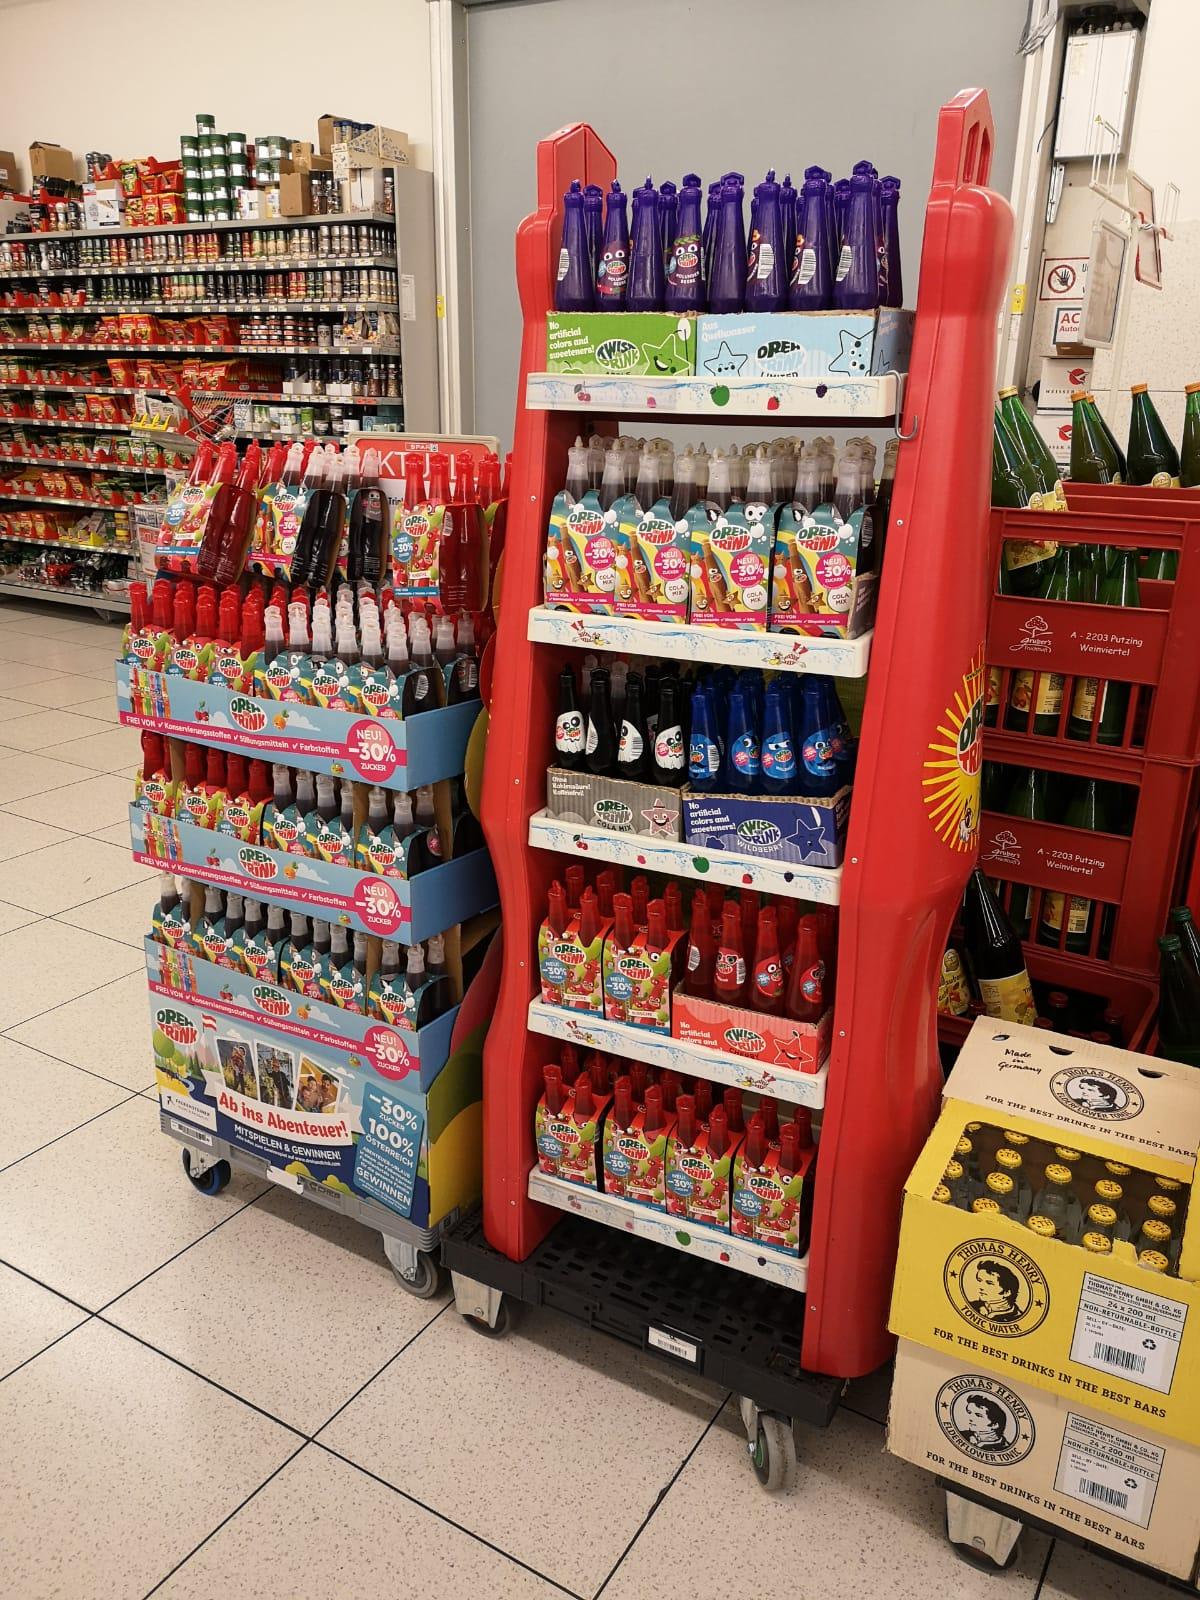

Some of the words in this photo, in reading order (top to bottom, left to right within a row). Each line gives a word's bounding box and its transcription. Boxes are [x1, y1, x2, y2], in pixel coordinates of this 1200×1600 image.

[549, 321, 560, 330] No
[702, 321, 719, 331] Aus
[549, 327, 581, 340] artificial
[549, 339, 573, 350] colors
[573, 336, 589, 346] and
[597, 340, 637, 360] TWIST
[757, 340, 801, 359] DREH
[549, 345, 595, 360] sweeteners!
[599, 348, 640, 370] DRINK
[638, 520, 673, 532] DREH
[799, 526, 835, 540] DREH
[654, 558, 686, 569] -30%
[816, 564, 850, 576] -30%
[1070, 631, 1077, 639] A
[1085, 632, 1109, 642] 2203
[1110, 634, 1144, 648] Putzing
[1079, 643, 1131, 656] Weinviertel
[231, 698, 261, 712] DREH
[126, 715, 140, 725] FREI
[141, 718, 155, 728] VON
[164, 721, 232, 740] Konservierungsstoffen
[239, 735, 289, 749] Süßungsmitteln
[299, 743, 340, 755] Farbstoffen
[356, 729, 382, 741] NEU!
[349, 742, 396, 763] -30%
[360, 762, 387, 772] ZUCKER
[596, 800, 629, 811] DREH
[688, 802, 700, 810] No
[689, 808, 721, 818] artificial
[597, 819, 616, 831] COLA
[619, 823, 632, 832] MIX
[690, 816, 714, 826] colors
[715, 815, 730, 823] and
[738, 820, 777, 835] TWIST
[691, 823, 737, 834] sweeteners!
[742, 828, 781, 844] DRINK
[737, 839, 783, 853] WILDBERRY
[239, 849, 272, 863] DREH
[1051, 850, 1073, 860] 2203
[1074, 854, 1105, 869] Putzing
[1046, 859, 1094, 876] Weinviertel
[140, 855, 154, 865] FREI
[155, 858, 169, 869] VON
[177, 864, 242, 884] Konservierungsstoffen
[249, 881, 299, 897] Süßungsmitteln
[308, 893, 348, 907] Farbstoffen
[363, 885, 388, 898] NEU!
[355, 897, 402, 919] -30%
[367, 916, 392, 926] ZUCKER
[554, 944, 582, 954] DREH
[542, 967, 567, 976] -30%
[253, 986, 287, 1001] DREH
[155, 985, 169, 995] FREI
[170, 989, 184, 999] VON
[191, 995, 255, 1019] Konservierungsstoffen
[263, 1016, 310, 1037] Süßungsmitteln
[319, 1034, 357, 1050] Farbstoffen
[157, 1008, 194, 1027] DREH
[680, 1021, 690, 1029] No
[373, 1033, 397, 1047] NEU!
[680, 1029, 711, 1039] artificial
[726, 1028, 762, 1042] TWIST
[703, 1038, 718, 1046] and
[365, 1043, 410, 1067] -30%
[1004, 1048, 1032, 1058] Made
[1012, 1056, 1025, 1064] in
[376, 1060, 401, 1073] ZUCKER
[997, 1061, 1042, 1075] Germany
[1063, 1068, 1104, 1079] THOMAS
[1107, 1073, 1138, 1096] HENRY
[369, 1093, 417, 1131] -30%
[1056, 1091, 1108, 1119] ELDERFLOWER
[1108, 1109, 1133, 1120] TONIC
[219, 1091, 239, 1113] Ab
[241, 1101, 264, 1124] ins
[267, 1111, 349, 1138] Abenteuer!
[379, 1112, 405, 1133] ZUCKER
[984, 1095, 1004, 1105] FOR
[1007, 1100, 1027, 1111] THE
[1029, 1106, 1054, 1119] BEST
[1056, 1114, 1096, 1130] DRINKS
[1099, 1126, 1112, 1135] IN
[1114, 1130, 1135, 1142] THE
[1138, 1136, 1165, 1150] BEST
[1167, 1144, 1197, 1158] BARS
[234, 1124, 282, 1151] MITSPIELEN
[284, 1143, 291, 1152] &
[291, 1145, 342, 1160] GEWINNEN!
[368, 1117, 414, 1157] 100%
[365, 1133, 414, 1169] ÖSTERREICH
[356, 1166, 411, 1207] GEWINNEN
[750, 1178, 780, 1189] DREH
[957, 1242, 1005, 1261] THOMAS
[1007, 1249, 1042, 1285] HENRY
[1087, 1280, 1113, 1293] THOMAS
[1113, 1288, 1134, 1299] HENRY
[1135, 1294, 1154, 1306] GMBH
[1161, 1302, 1171, 1312] CO.
[1173, 1307, 1182, 1315] KG
[960, 1304, 987, 1329] TONIC
[988, 1323, 1022, 1334] WATER
[1107, 1300, 1118, 1310] 24
[1127, 1307, 1144, 1318] 200
[1145, 1312, 1157, 1323] ml
[1083, 1302, 1178, 1339] NON-RETURNABLE-BOTTLE
[933, 1327, 954, 1342] FOR
[957, 1335, 979, 1351] THE
[981, 1344, 1009, 1361] BEST
[1011, 1355, 1055, 1378] DRINKS
[1058, 1371, 1071, 1385] IN
[1075, 1378, 1099, 1394] THE
[1102, 1387, 1131, 1406] BEST
[1133, 1399, 1167, 1418] BARS
[947, 1378, 993, 1395] THOMAS
[996, 1386, 1028, 1421] HENRY
[943, 1421, 997, 1462] ELDERFLOWER
[997, 1447, 1022, 1462] TONIC
[1089, 1439, 1100, 1448] 24
[1108, 1446, 1123, 1457] 200
[1125, 1452, 1135, 1462] ml
[1066, 1440, 1155, 1479] NON-RETURNABLE-BOTTLE
[926, 1451, 946, 1466] FOR
[948, 1460, 969, 1475] THE
[971, 1470, 998, 1487] BEST
[999, 1482, 1041, 1505] DRINKS
[1043, 1500, 1057, 1512] IN
[1059, 1506, 1081, 1522] THE
[1084, 1517, 1112, 1536] BEST
[1114, 1530, 1145, 1550] BARS
